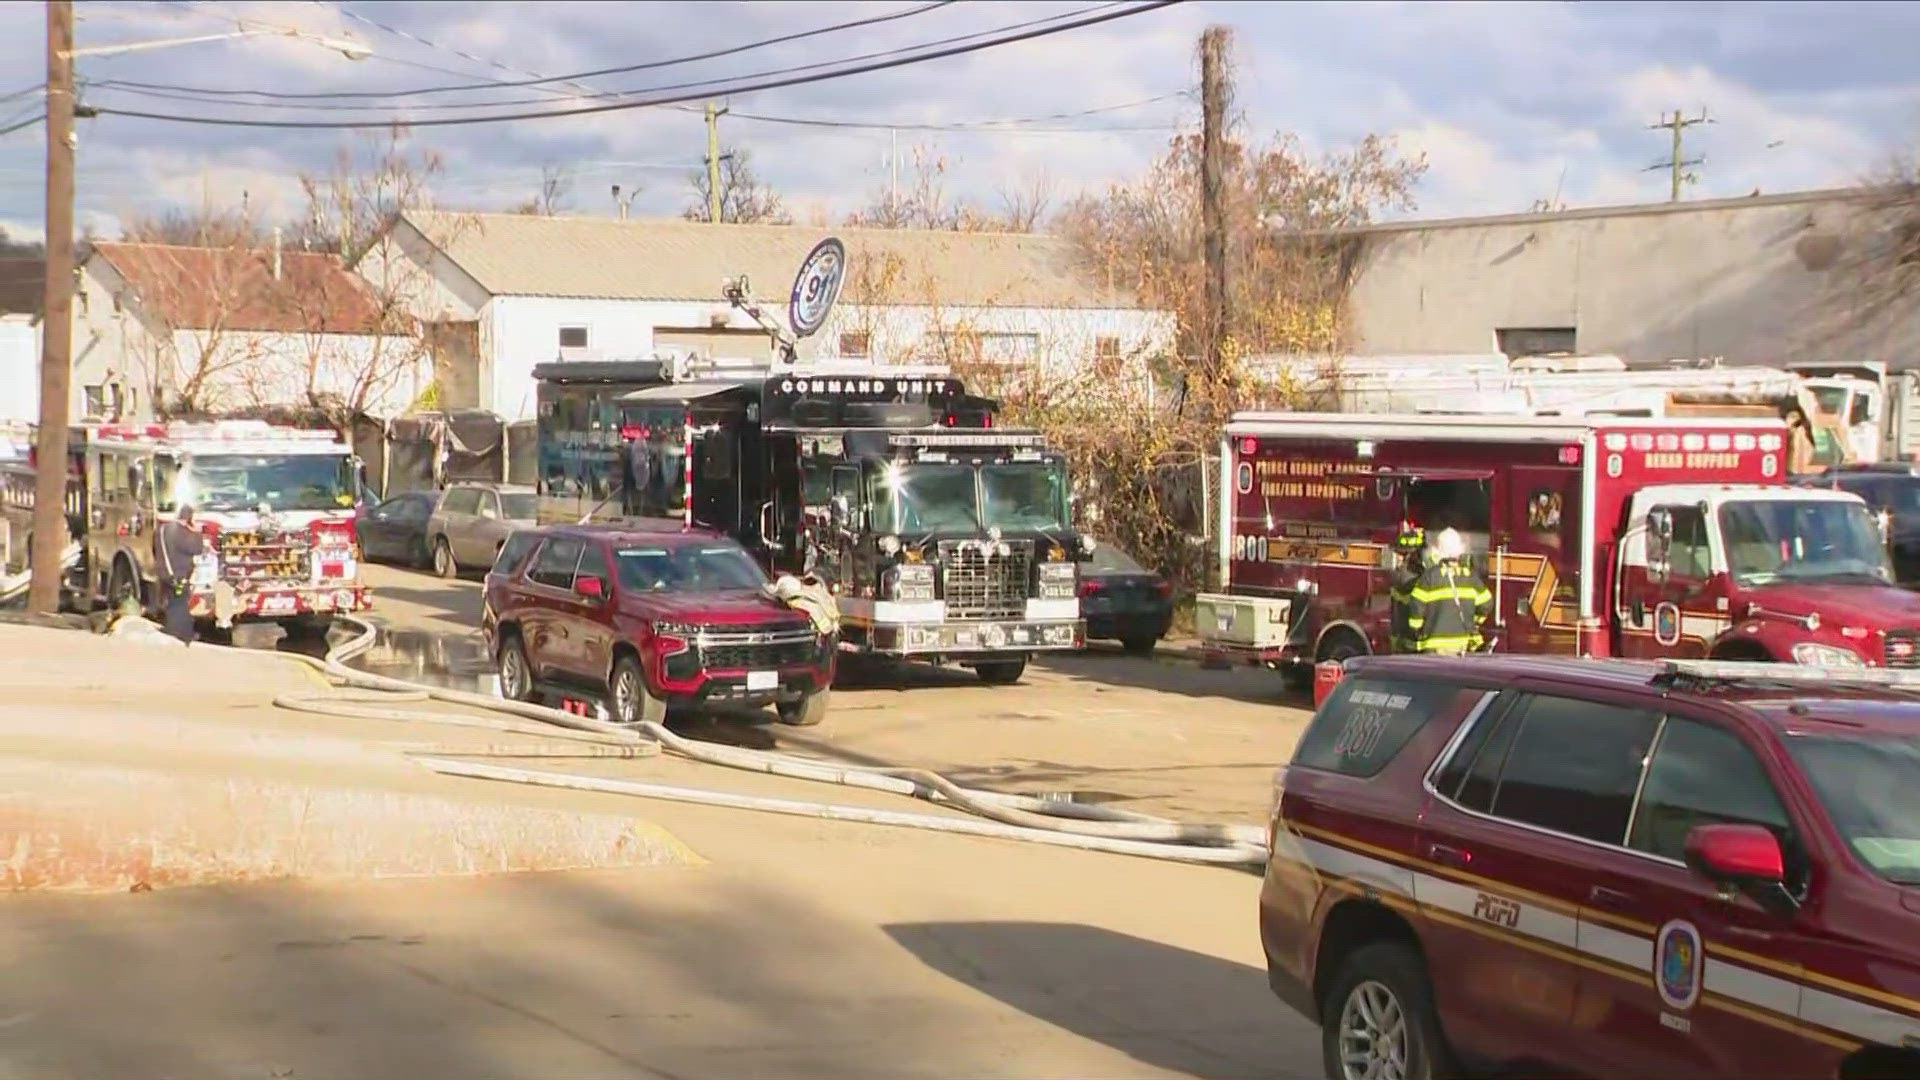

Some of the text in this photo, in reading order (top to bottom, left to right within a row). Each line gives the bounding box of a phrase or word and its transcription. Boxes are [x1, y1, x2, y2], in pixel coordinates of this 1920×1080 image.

[806, 275, 836, 303] 911
[781, 379, 946, 394] COMMAND UNIT
[1256, 461, 1288, 475] PRINCE
[1646, 453, 1739, 468] REHAB SUPPORT
[1261, 482, 1365, 499] FIRE/EMS DEPARTMENT
[1473, 892, 1522, 928] PGFD
